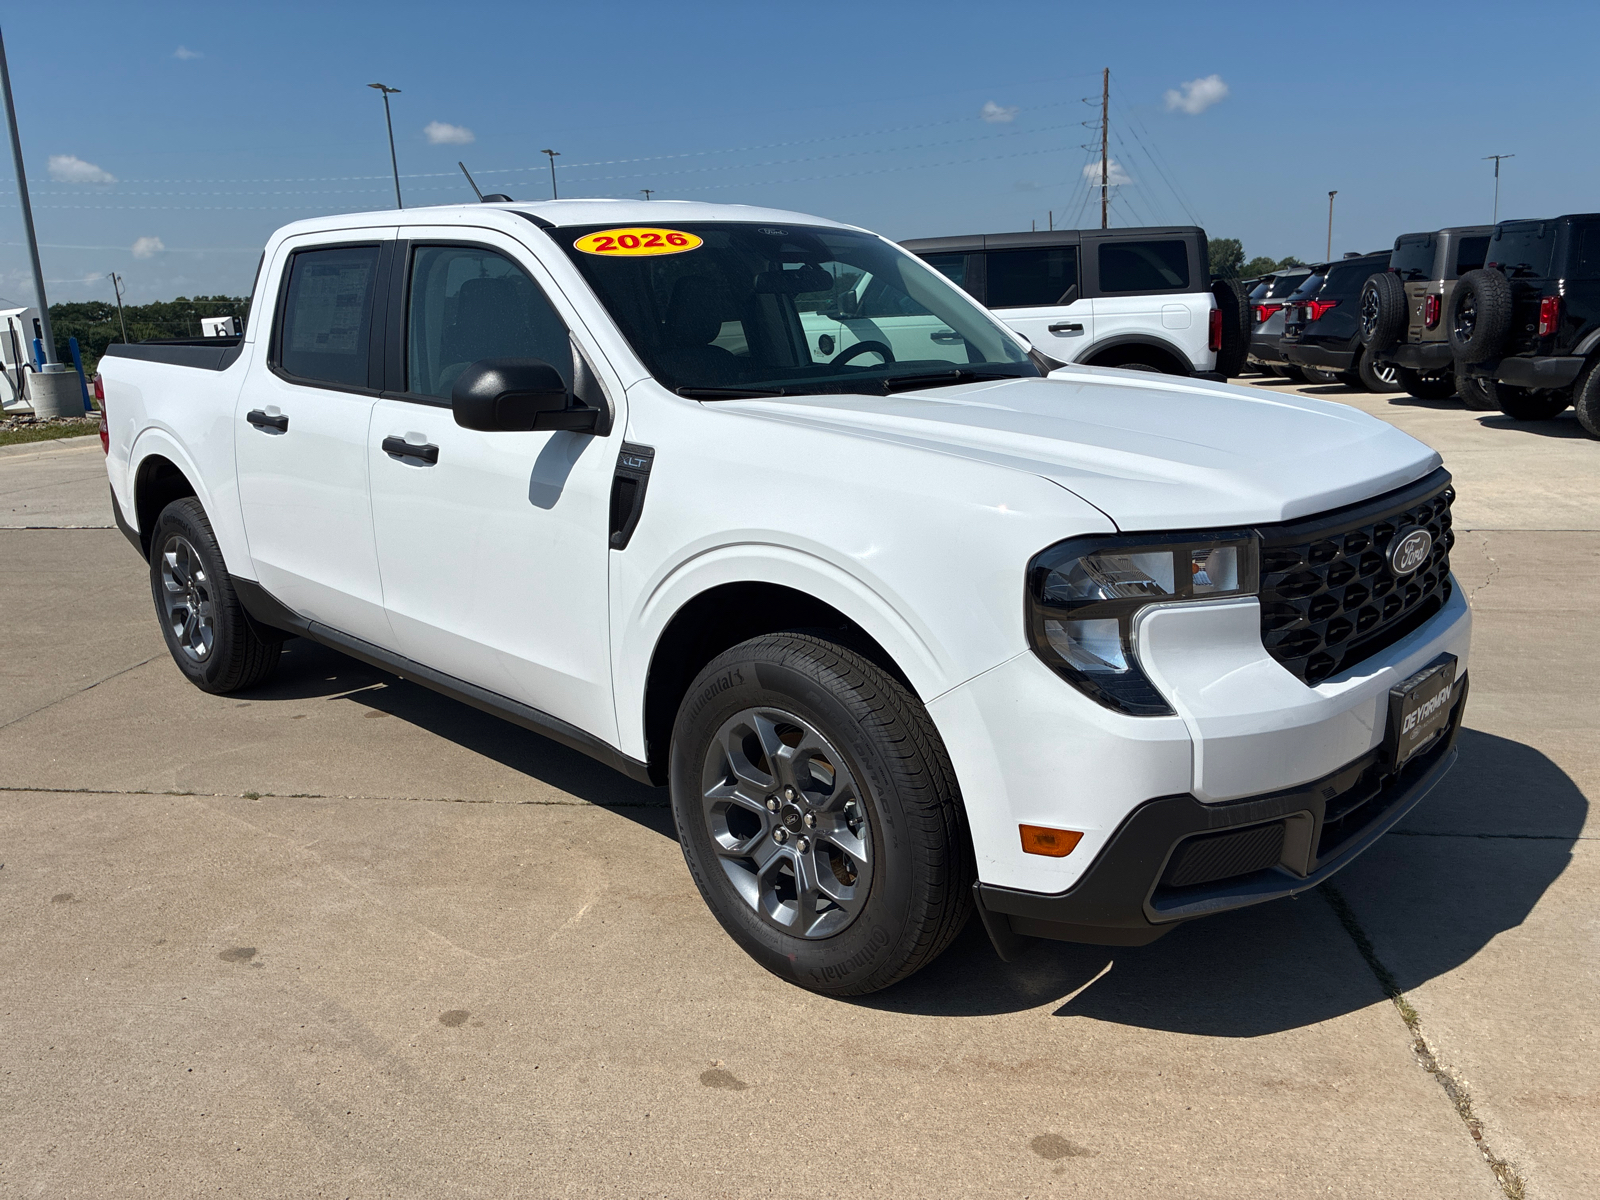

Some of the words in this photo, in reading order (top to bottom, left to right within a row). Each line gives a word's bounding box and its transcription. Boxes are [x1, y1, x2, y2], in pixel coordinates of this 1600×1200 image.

[592, 232, 690, 252] 2026
[620, 455, 647, 468] XLT
[1401, 536, 1426, 569] Ford
[681, 670, 735, 738] Continental
[1402, 683, 1453, 735] DEYARMAN
[819, 924, 890, 983] Continental
